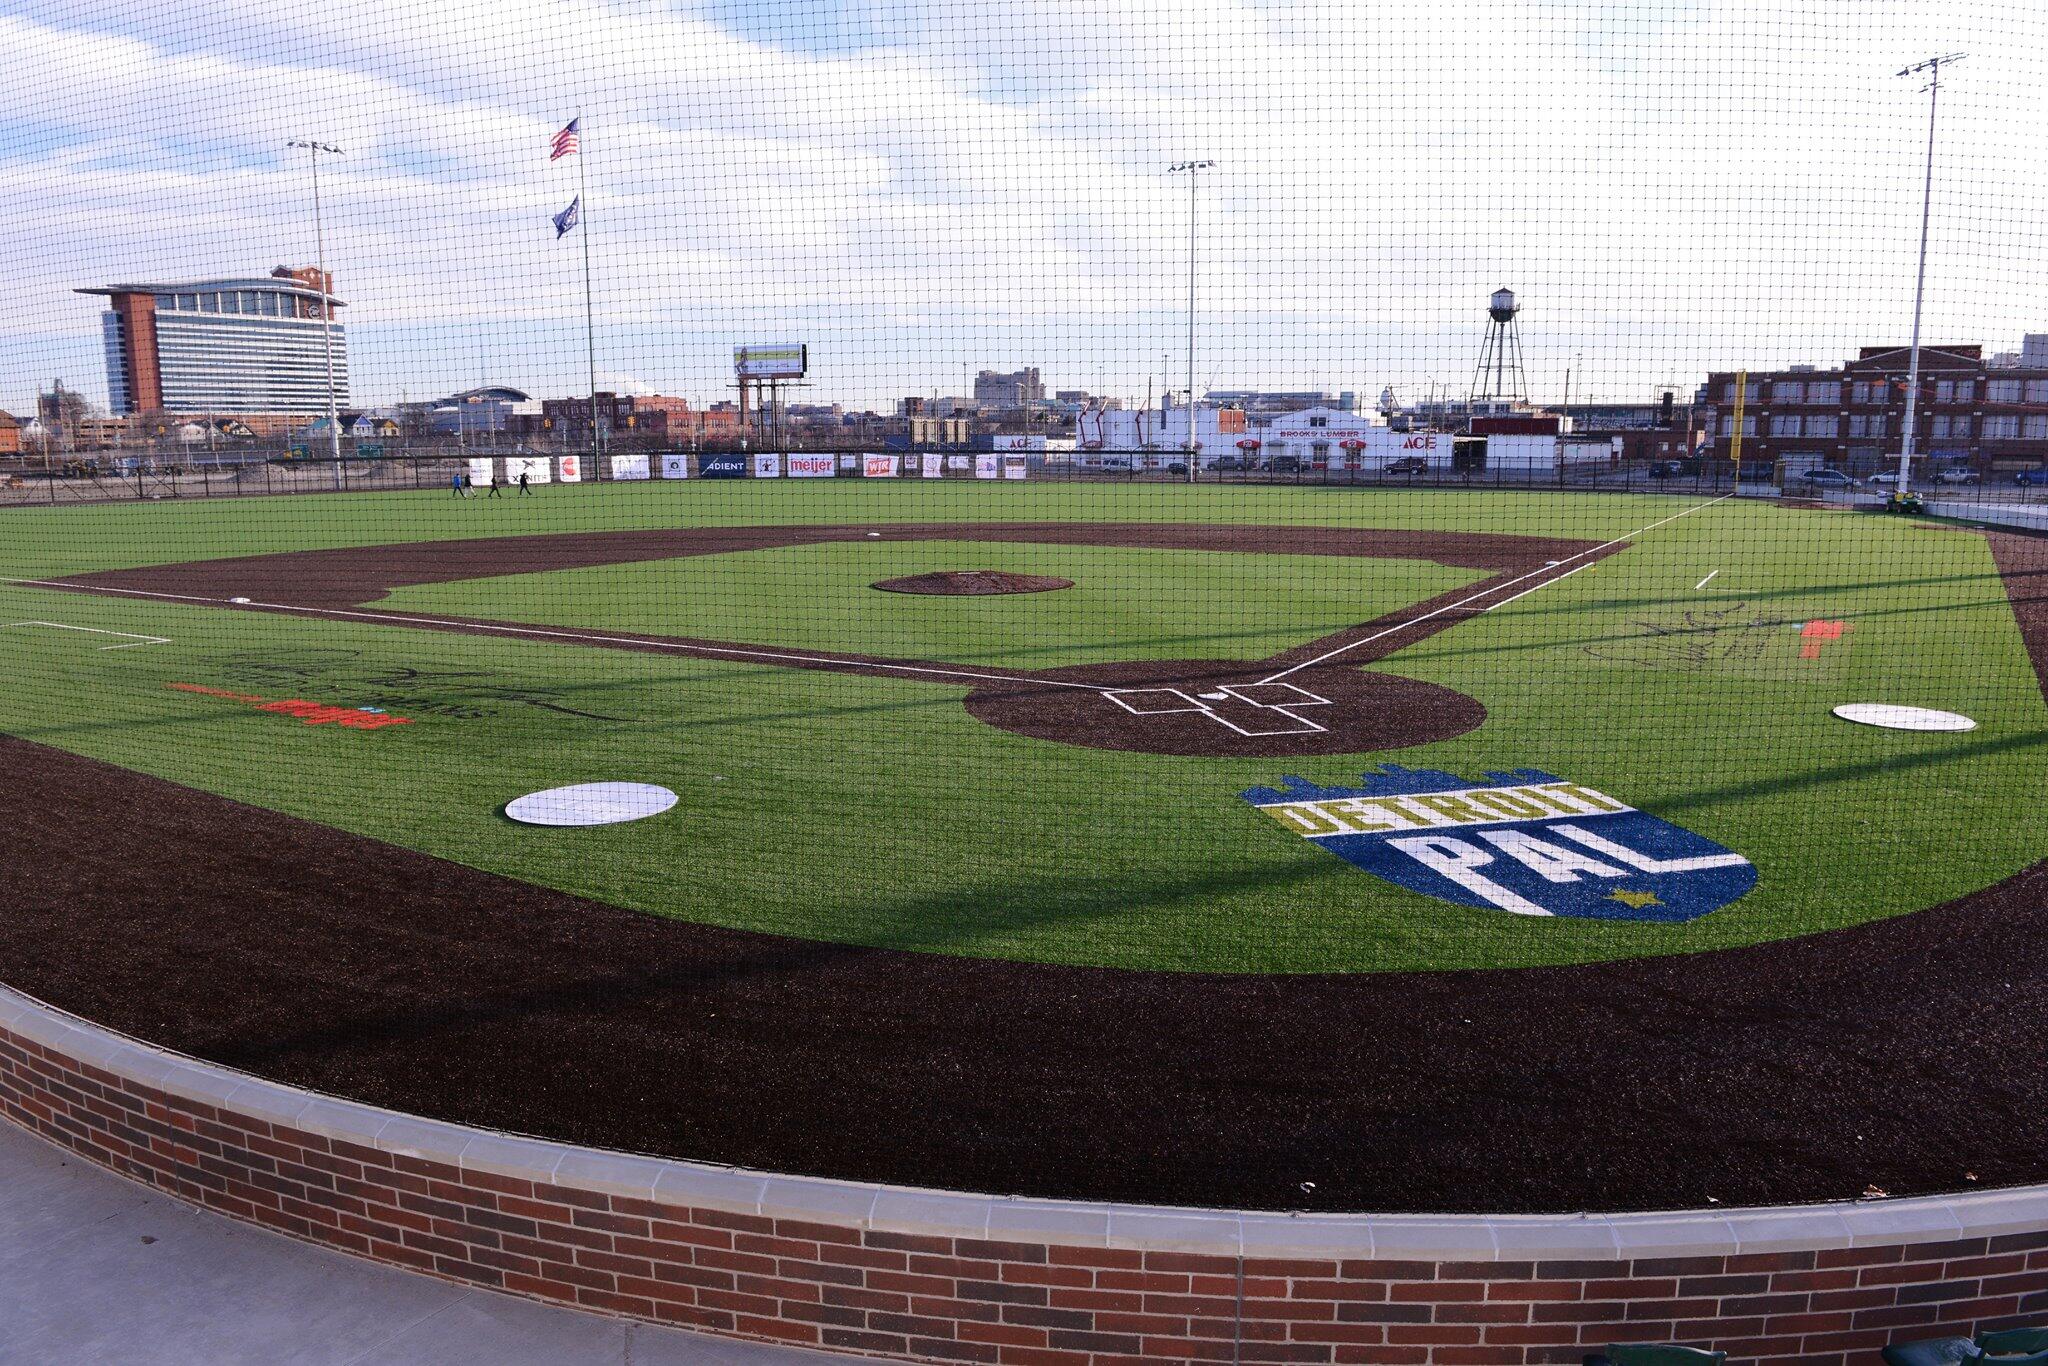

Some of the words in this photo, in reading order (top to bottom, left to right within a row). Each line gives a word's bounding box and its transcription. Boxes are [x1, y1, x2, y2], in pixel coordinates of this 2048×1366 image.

[1280, 430, 1318, 438] BROOKS
[1321, 430, 1360, 438] LUMBER
[1403, 437, 1437, 449] ACE
[707, 462, 744, 470] ADIENT
[790, 457, 832, 473] meijer
[512, 474, 548, 484] XNITH
[1260, 784, 1627, 837] DETROIT
[1386, 824, 1751, 917] PAL
